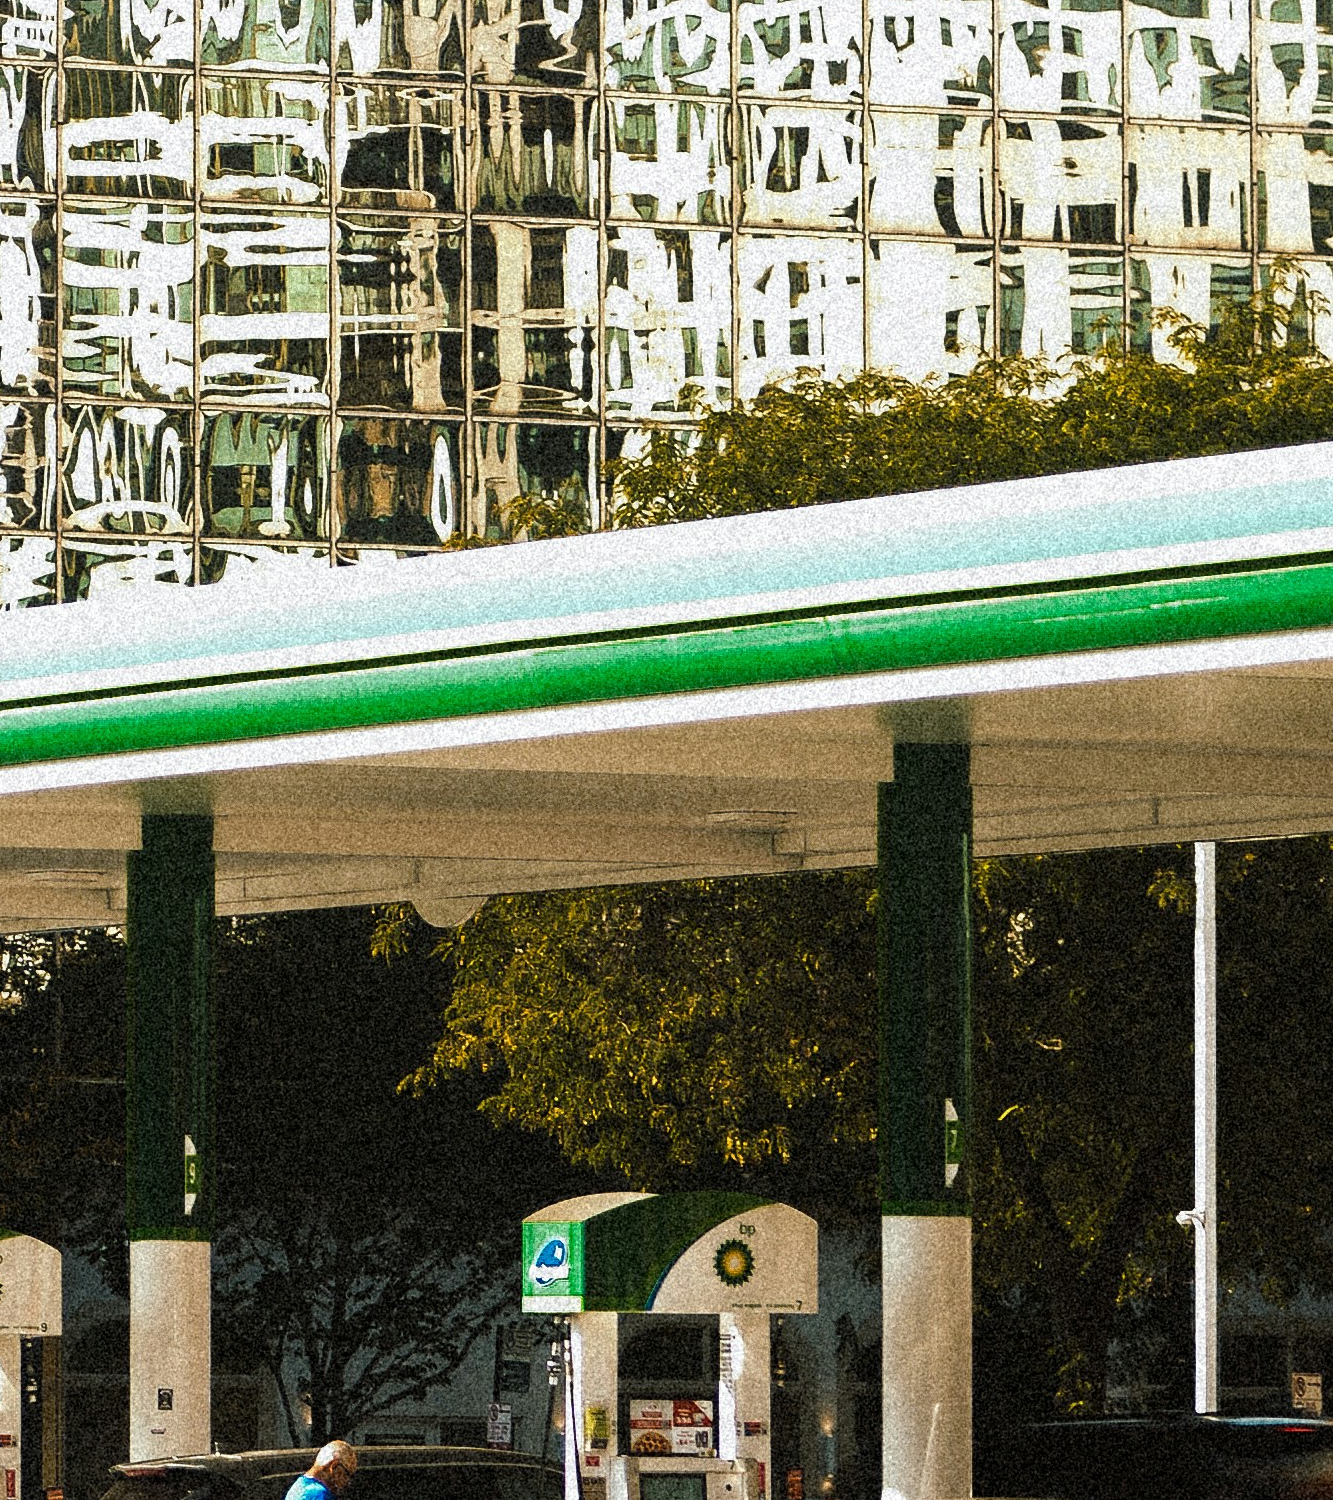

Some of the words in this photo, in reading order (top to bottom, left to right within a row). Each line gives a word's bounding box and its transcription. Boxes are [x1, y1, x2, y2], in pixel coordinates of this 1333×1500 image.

[738, 1221, 756, 1238] bp
[795, 1299, 803, 1311] 7
[40, 1322, 49, 1333] 9
